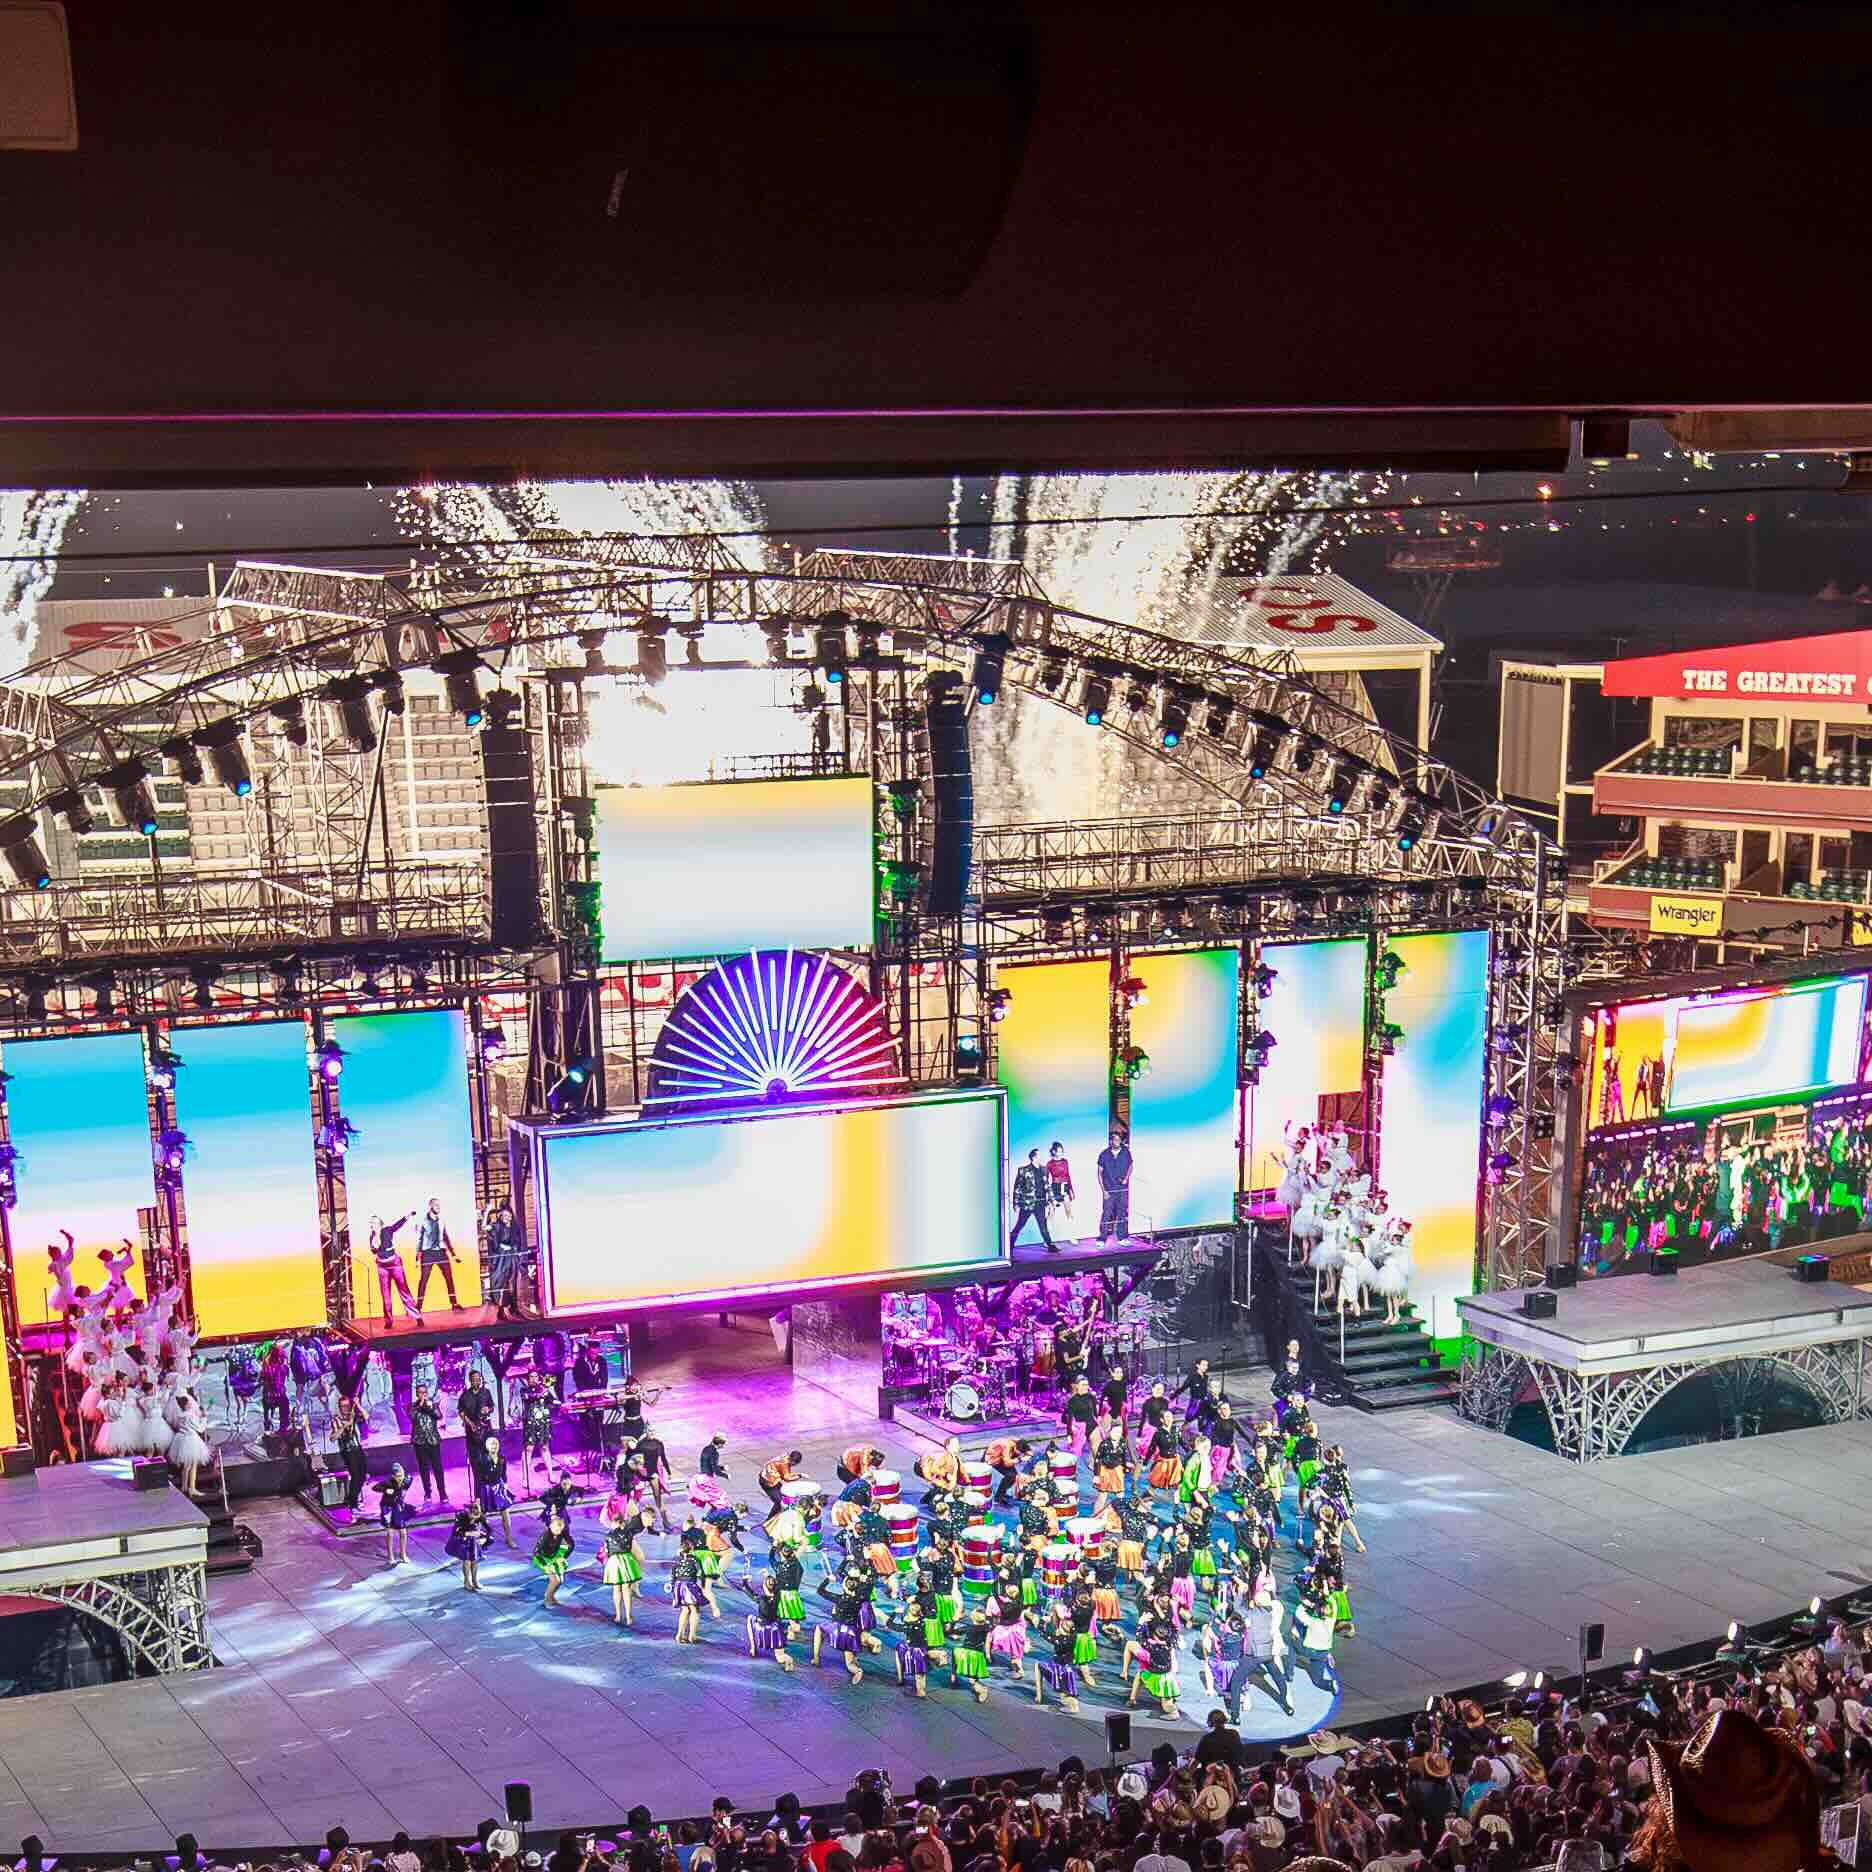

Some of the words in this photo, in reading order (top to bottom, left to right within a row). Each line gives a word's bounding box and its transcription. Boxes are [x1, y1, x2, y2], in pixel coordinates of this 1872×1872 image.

[1682, 669, 1728, 692] THE
[1736, 671, 1857, 695] GREATEST
[1657, 902, 1716, 928] Wrangler
